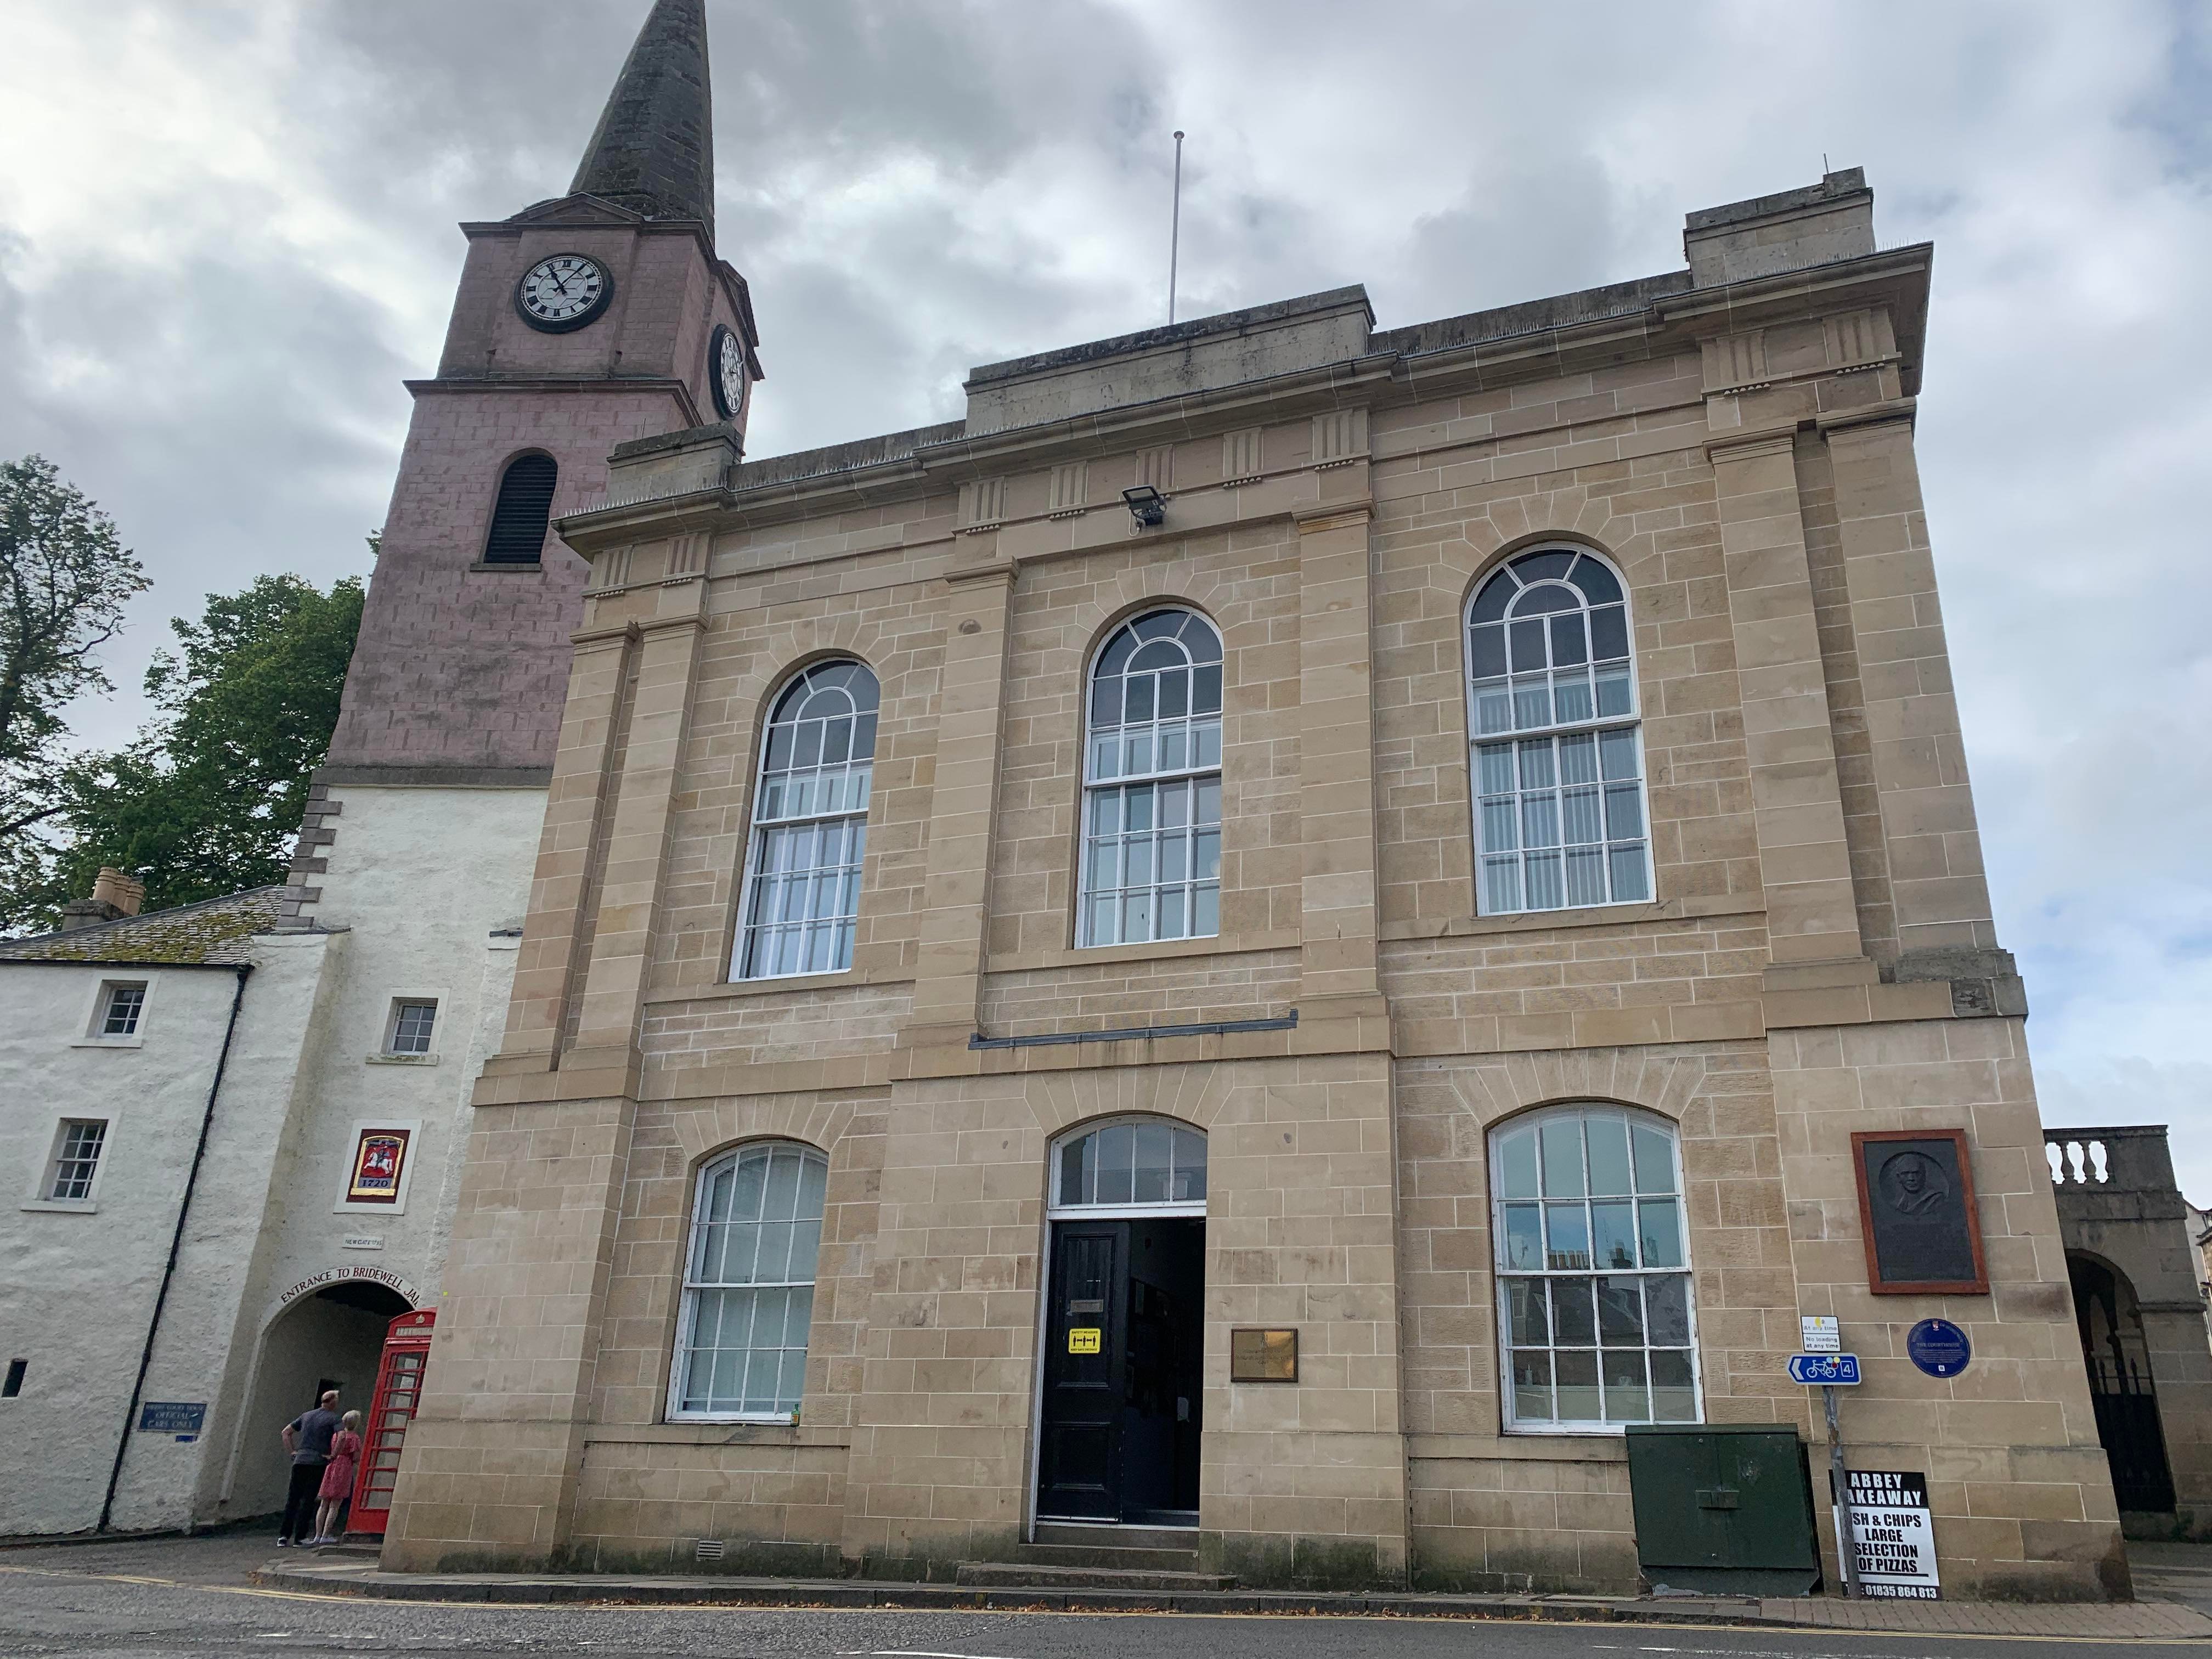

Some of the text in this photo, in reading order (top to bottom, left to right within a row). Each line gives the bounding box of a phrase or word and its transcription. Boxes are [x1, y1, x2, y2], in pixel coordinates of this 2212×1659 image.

[281, 1267, 420, 1308] ENTRANCE TO BRIDEWELL JAIL
[1843, 1364, 1852, 1374] 4
[1850, 1472, 1901, 1489] ABBEY
[1847, 1489, 1921, 1506] AKEAWAY
[1872, 1515, 1881, 1526] &
[1884, 1514, 1922, 1528] CHIPS
[1865, 1528, 1903, 1542] LARGE
[1854, 1543, 1918, 1558] SELECTION
[1859, 1558, 1917, 1573] OF PIZZAS
[1866, 1585, 1896, 1597] 01835
[1898, 1585, 1917, 1598] 864
[1918, 1587, 1937, 1599] 813
